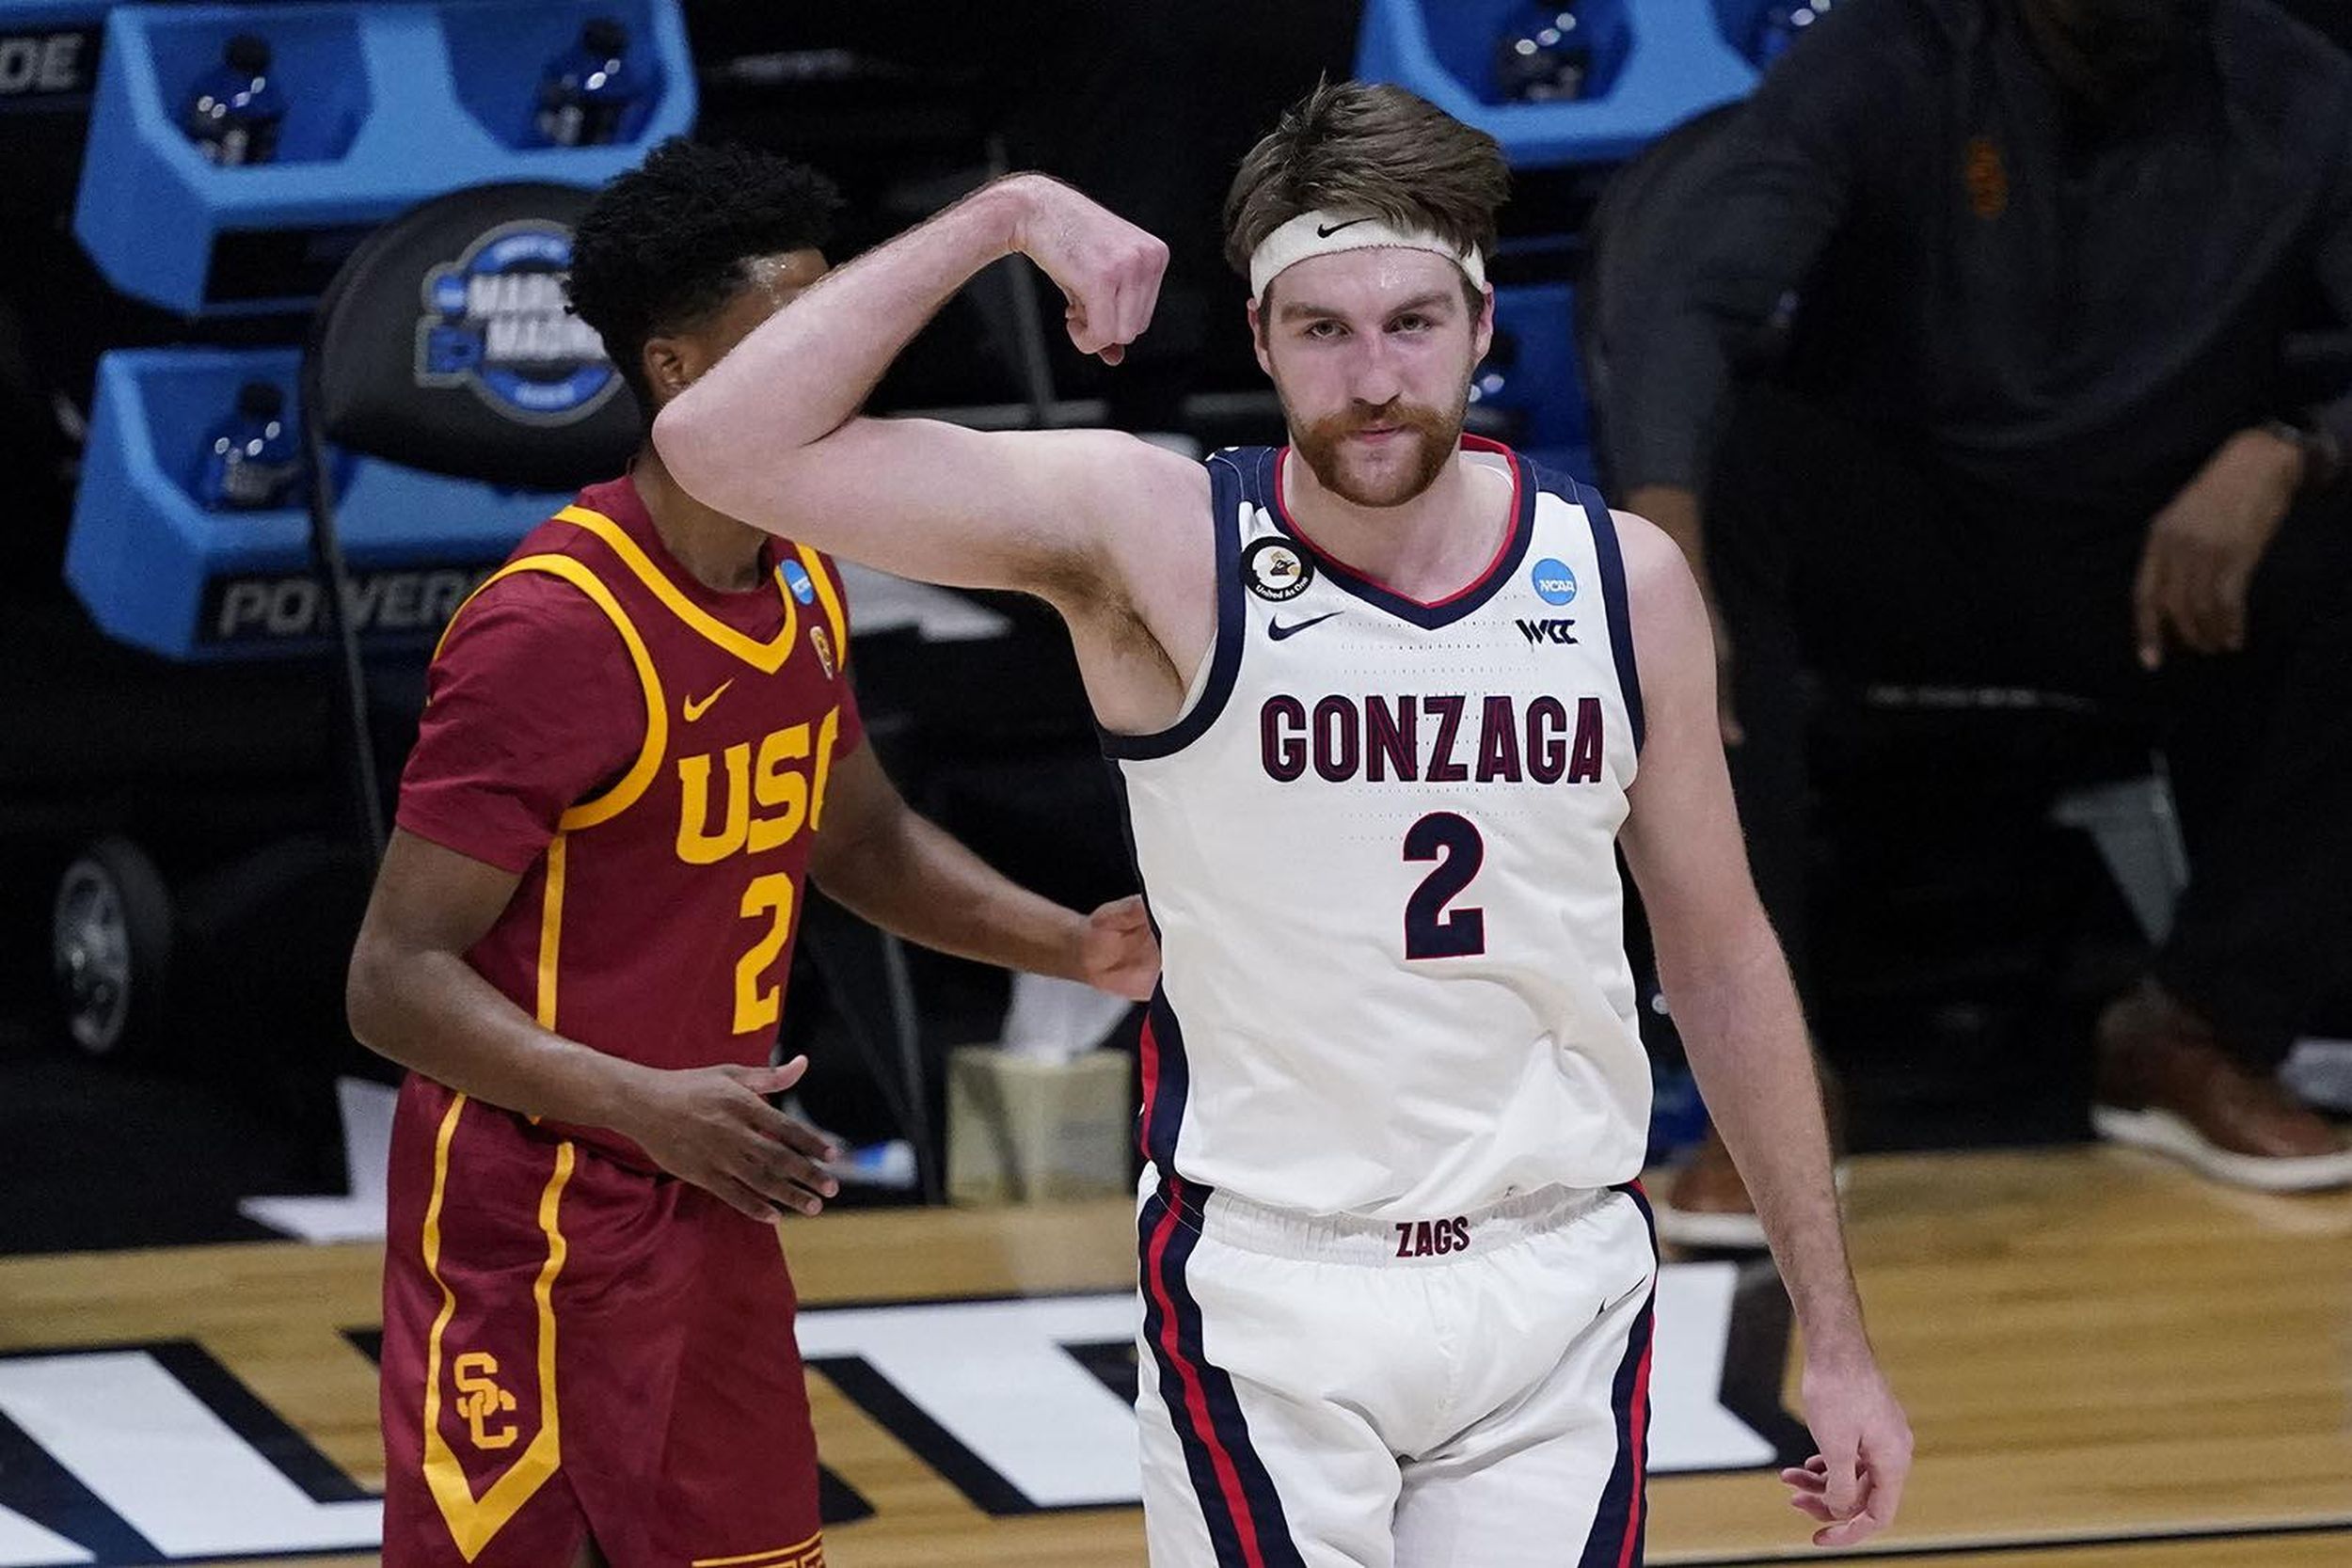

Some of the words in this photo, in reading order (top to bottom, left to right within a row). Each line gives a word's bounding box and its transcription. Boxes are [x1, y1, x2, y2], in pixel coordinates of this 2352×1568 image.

[1538, 579, 1576, 593] NCAA
[1515, 619, 1580, 645] WCC
[1260, 694, 1604, 784] GONZAGA
[1403, 811, 1486, 960] 2
[732, 872, 794, 1035] 2
[1395, 1215, 1470, 1258] ZAGS
